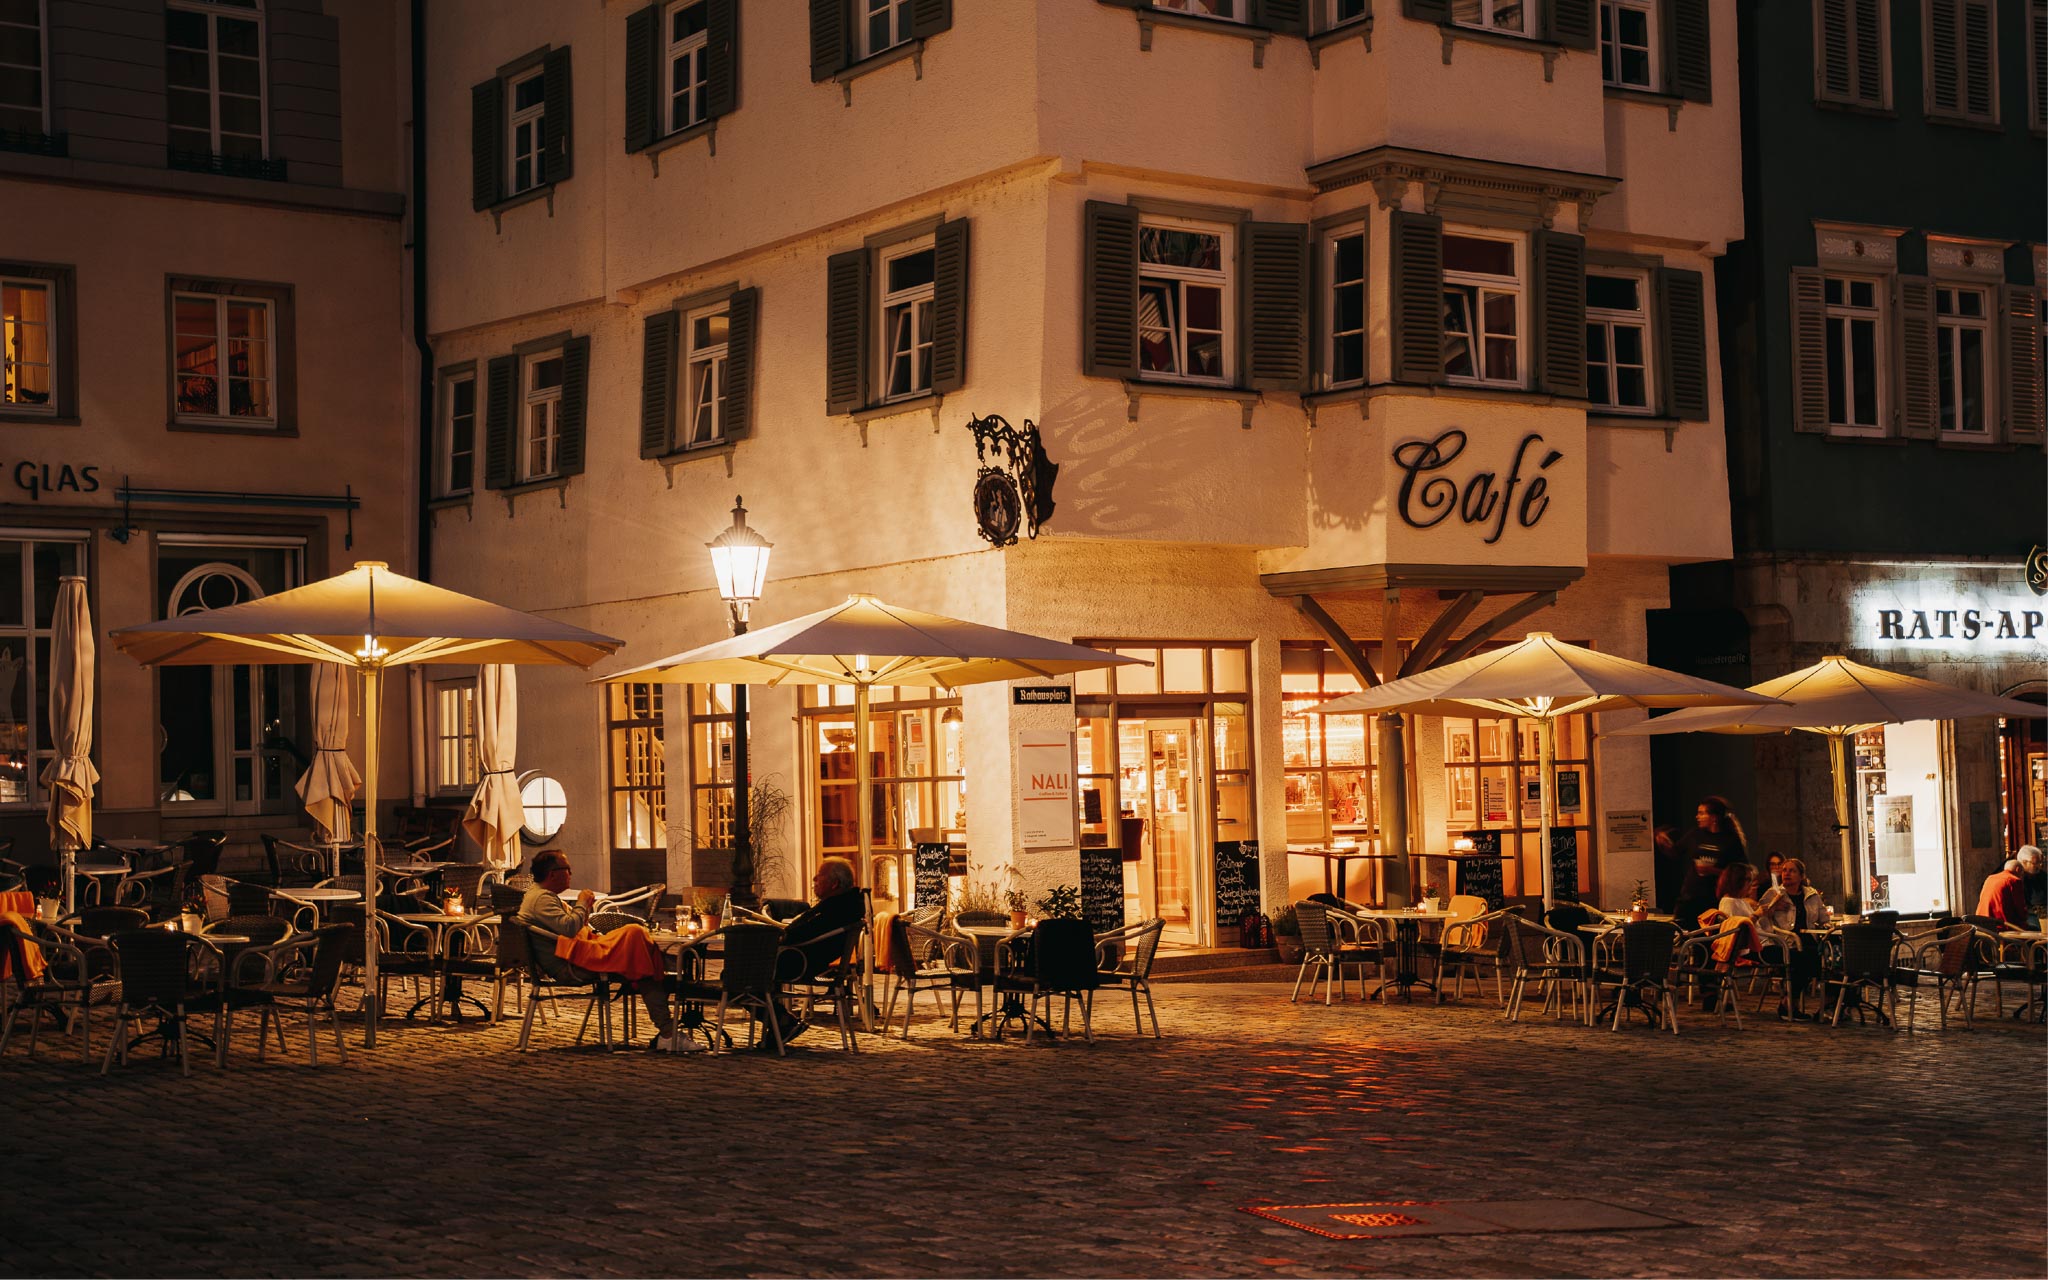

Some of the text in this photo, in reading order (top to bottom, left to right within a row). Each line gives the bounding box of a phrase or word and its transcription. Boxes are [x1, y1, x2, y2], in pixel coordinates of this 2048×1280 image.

[15, 461, 99, 500] GLAS
[1393, 430, 1563, 544] Café
[1020, 688, 1066, 702] Rathausplatz
[1032, 774, 1067, 790] NALI
